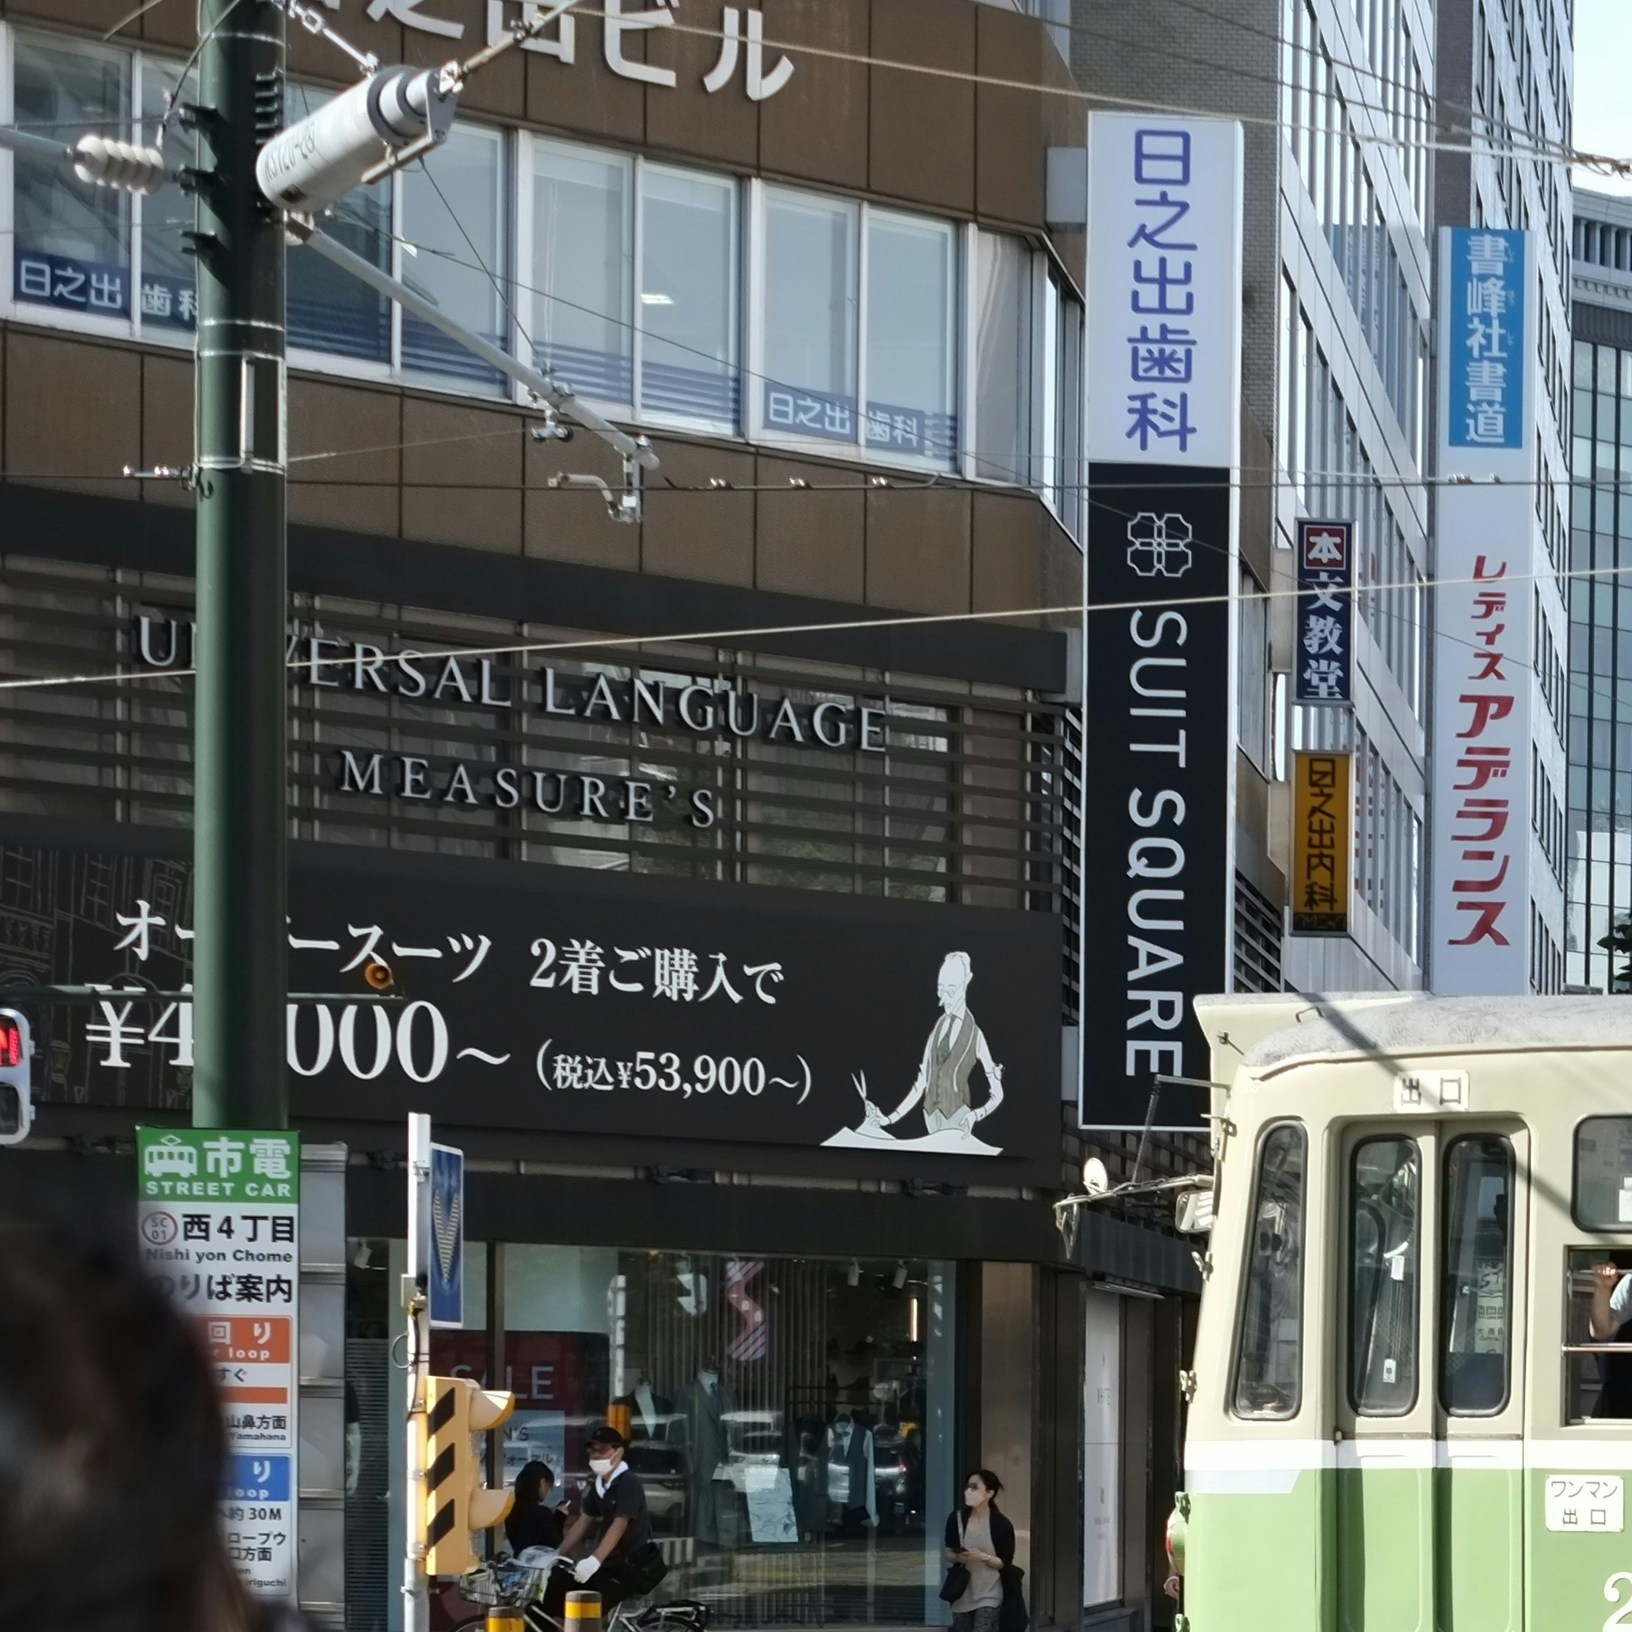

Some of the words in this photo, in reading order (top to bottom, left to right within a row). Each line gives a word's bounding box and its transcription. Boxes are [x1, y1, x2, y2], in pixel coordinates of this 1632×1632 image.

[1126, 129, 1198, 452] 日之出歯科
[1465, 233, 1509, 444] 書峰社書道
[1307, 531, 1343, 564] 本
[1303, 571, 1345, 699] 文教堂
[1467, 555, 1508, 682] レディス
[139, 615, 512, 707] UERSAL
[544, 666, 887, 752] LANGUAGE
[1128, 608, 1188, 769] SUIT
[341, 750, 714, 829] MEASURE'S
[1304, 758, 1338, 912] 日之出内科
[1447, 693, 1516, 946] アデランス
[113, 900, 491, 985] オースーツ
[531, 937, 784, 1005] 2着ご購入で
[1125, 788, 1188, 1078] SQUARE
[1401, 1077, 1462, 1105] 出口
[146, 1181, 236, 1197] STREET
[245, 1183, 292, 1198] CAR
[203, 1136, 293, 1180] 市電
[182, 1214, 295, 1243] 西4丁目
[196, 1251, 226, 1264] yon
[233, 1249, 293, 1263] Chome
[1551, 1480, 1618, 1499] ワンマン
[1562, 1508, 1607, 1526] 出口
